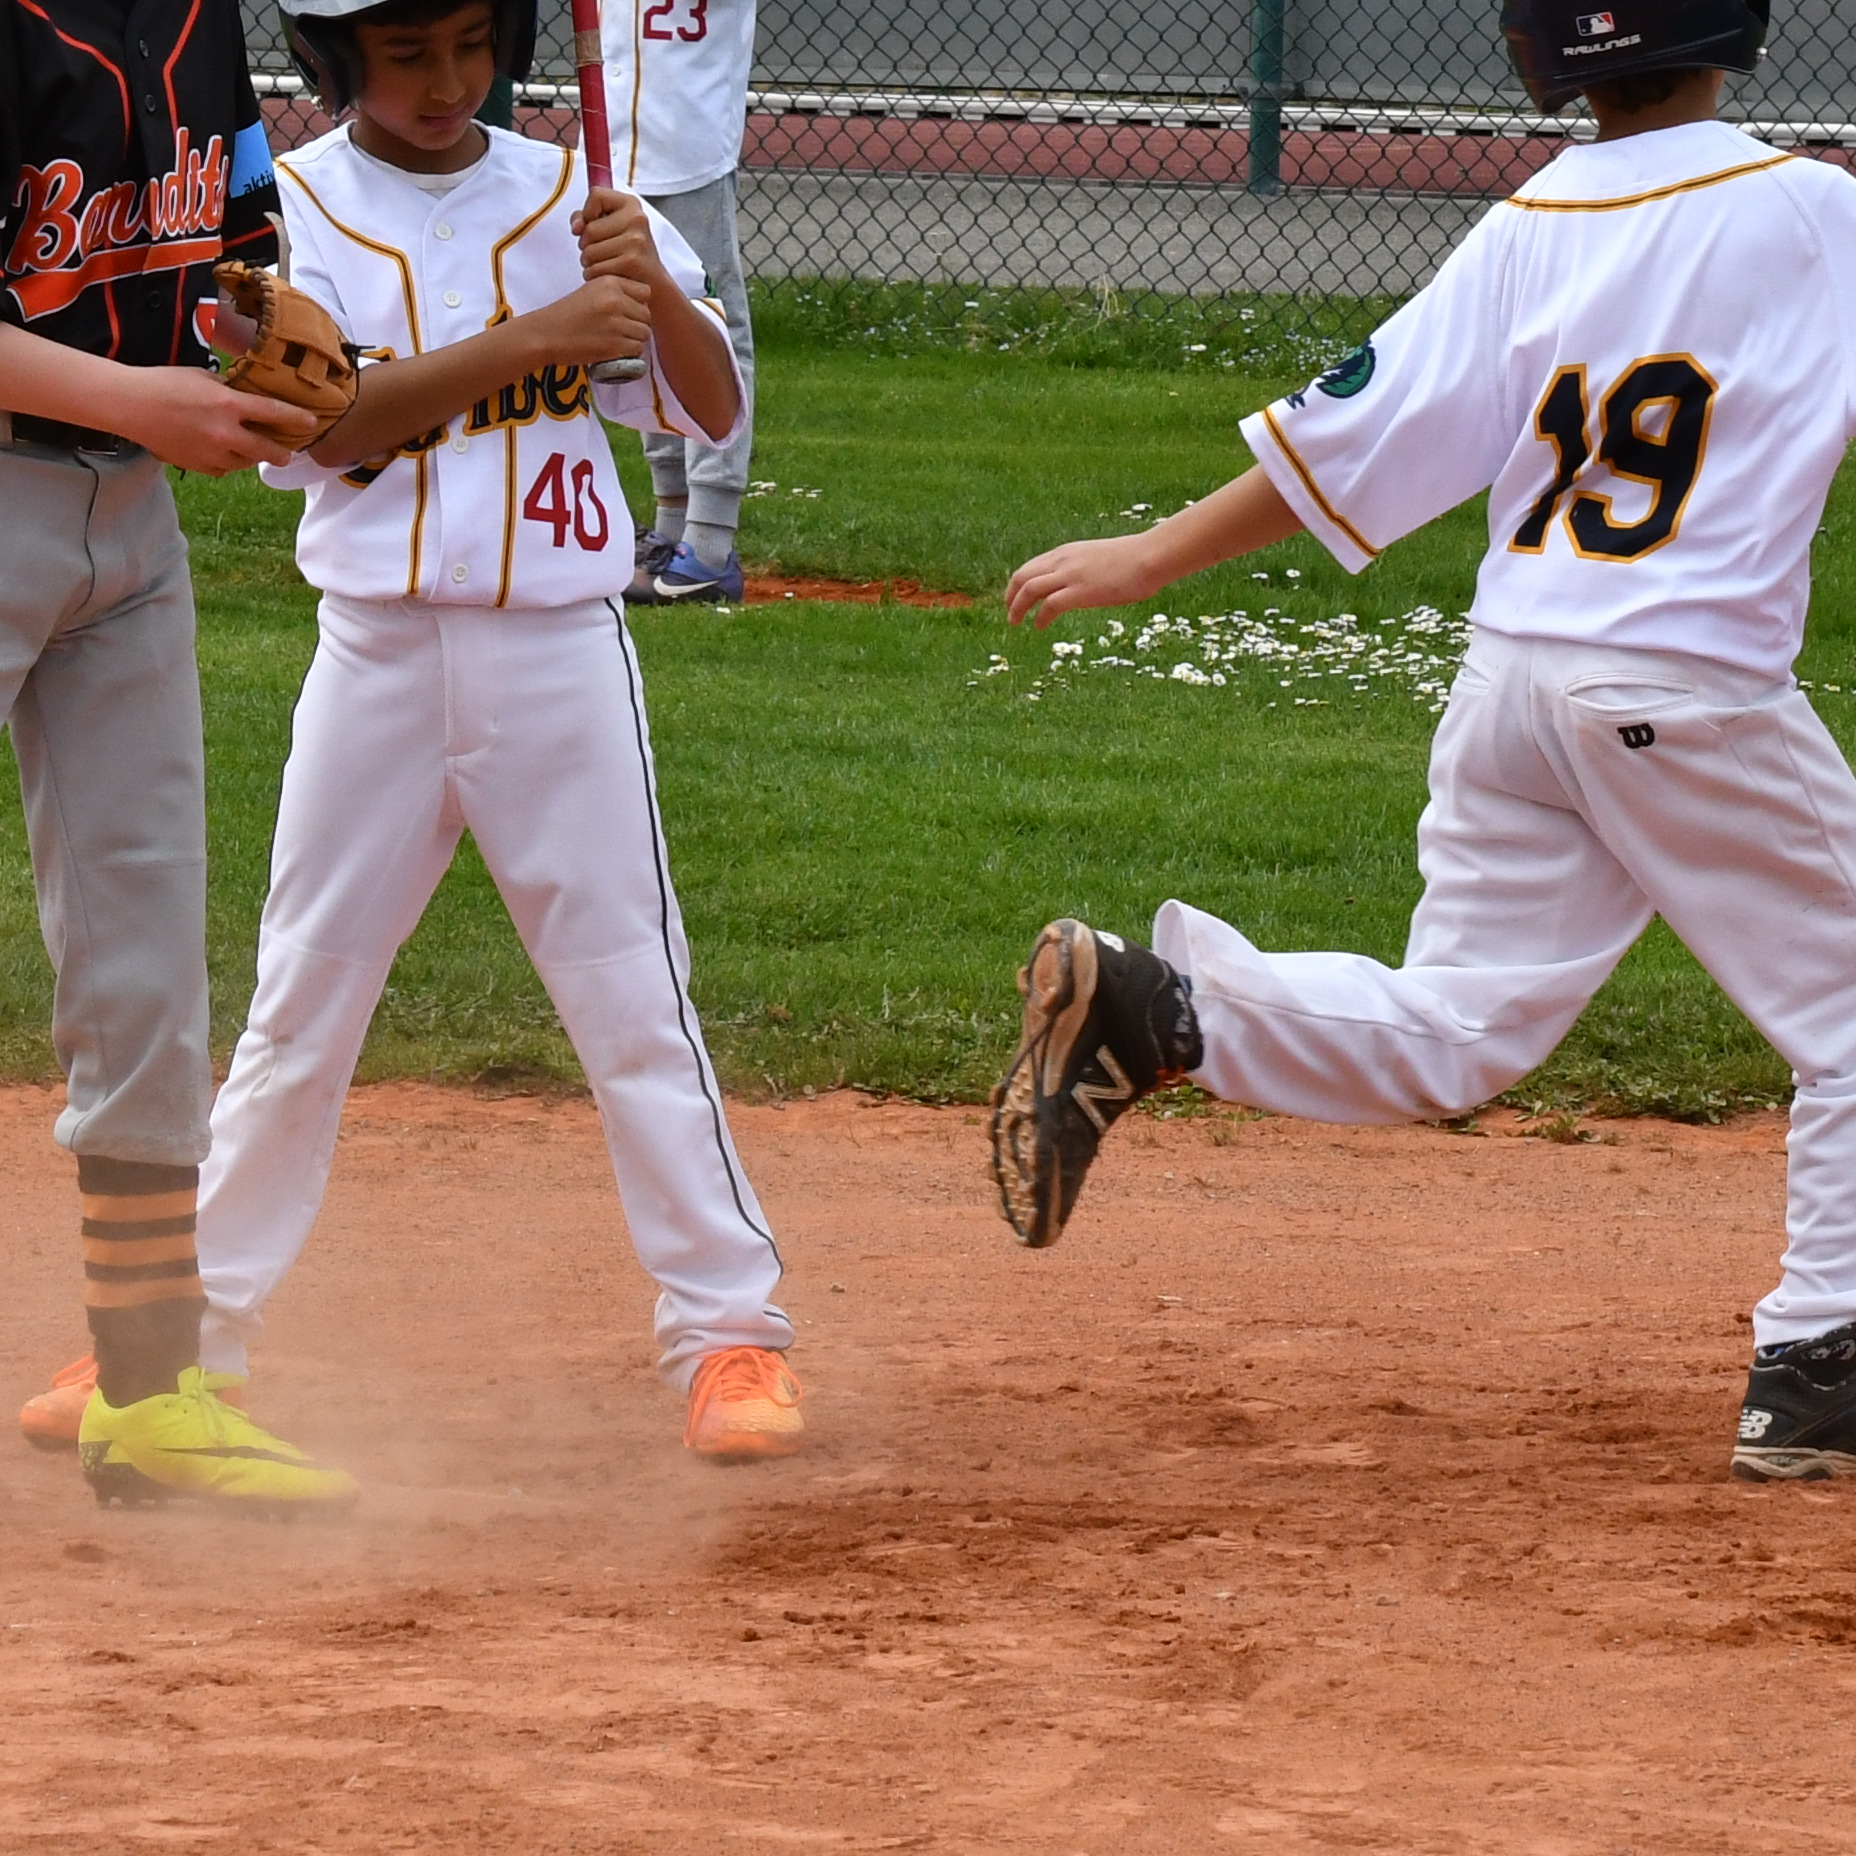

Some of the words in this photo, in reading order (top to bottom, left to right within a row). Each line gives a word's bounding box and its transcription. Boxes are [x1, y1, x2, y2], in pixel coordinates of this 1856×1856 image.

[1562, 33, 1642, 57] RAWLINGS
[522, 451, 610, 553] 40
[1507, 352, 1719, 564] 19
